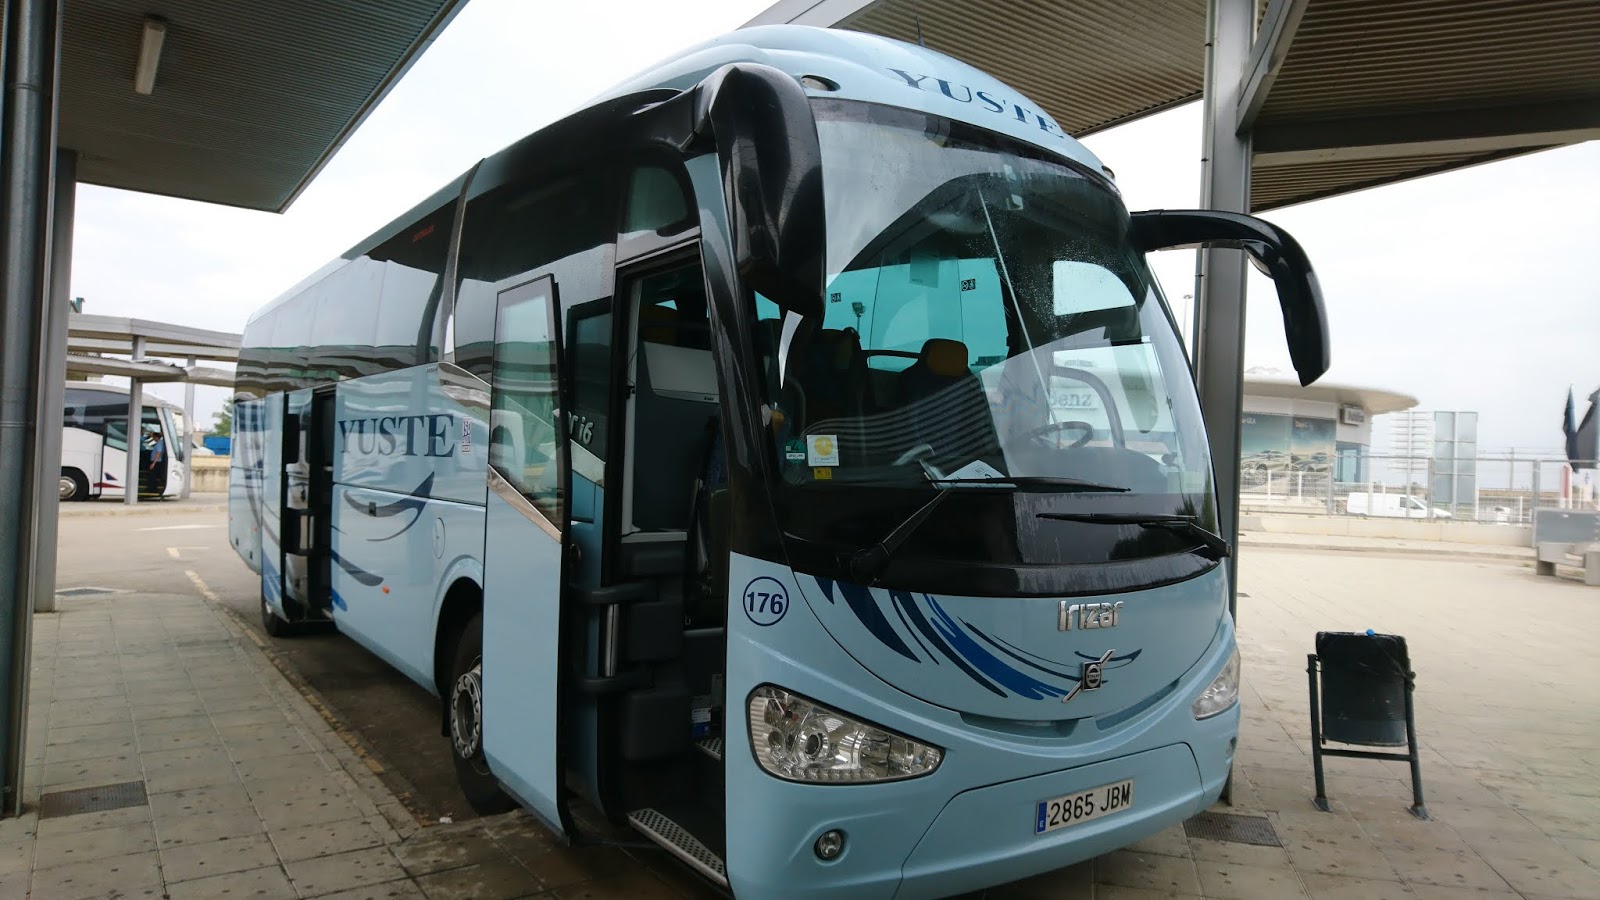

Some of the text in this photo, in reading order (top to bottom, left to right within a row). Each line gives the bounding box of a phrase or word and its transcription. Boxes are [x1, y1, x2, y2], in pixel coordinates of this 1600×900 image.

[885, 67, 1064, 139] YUSTE
[338, 414, 455, 457] YUSTE
[747, 591, 784, 615] 176
[1058, 600, 1124, 631] Irizar
[1049, 783, 1131, 827] 2865 JBM
